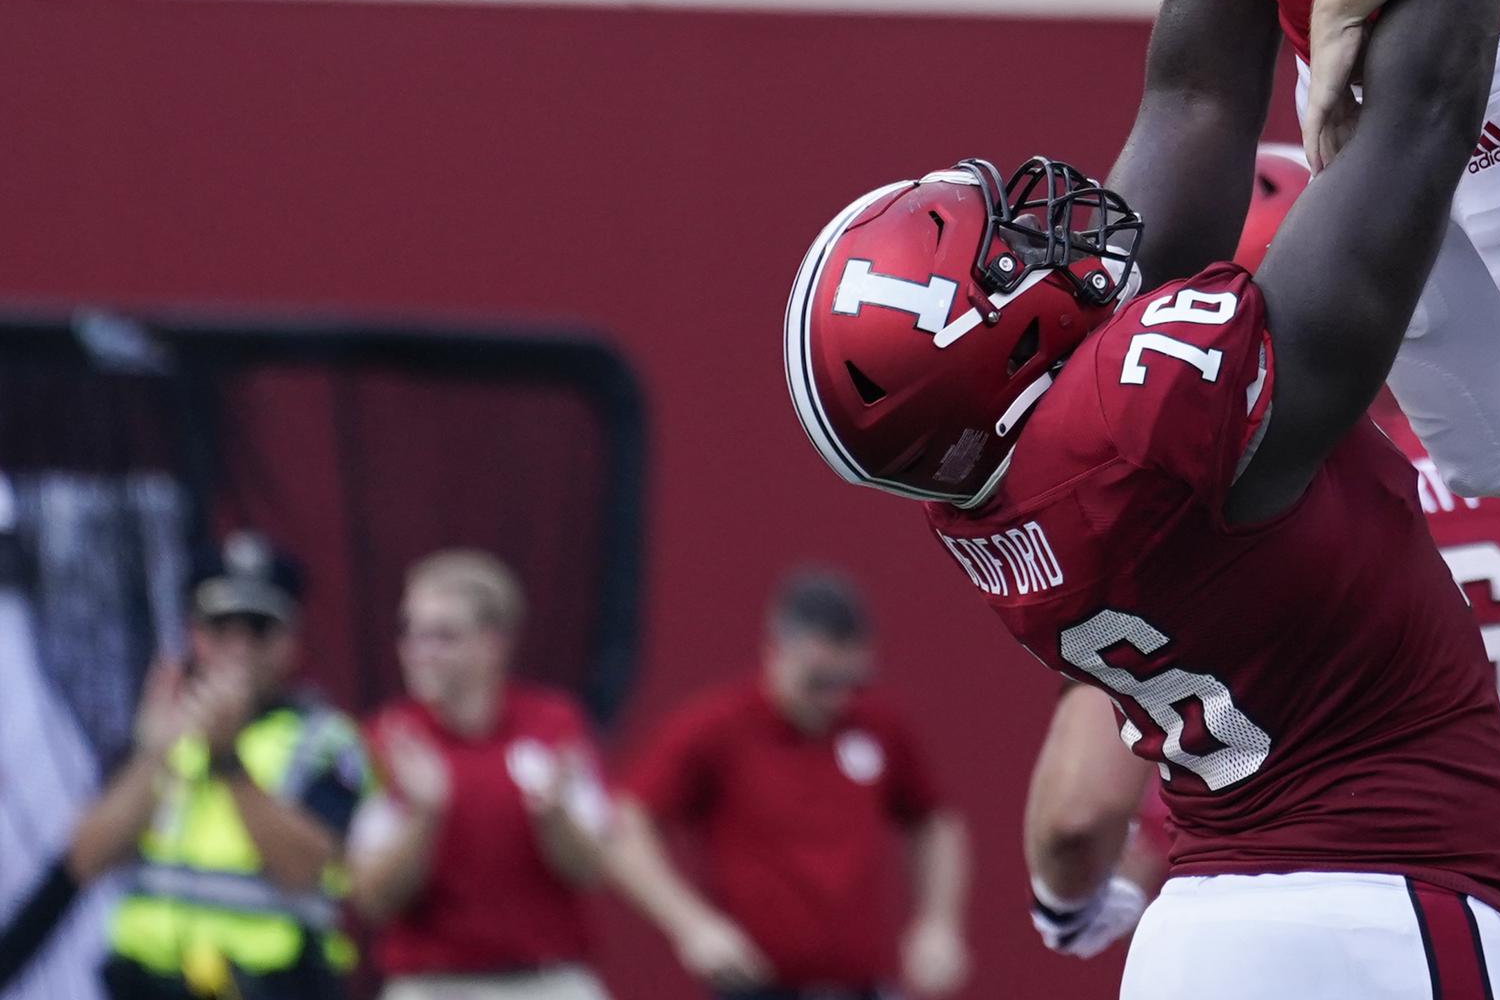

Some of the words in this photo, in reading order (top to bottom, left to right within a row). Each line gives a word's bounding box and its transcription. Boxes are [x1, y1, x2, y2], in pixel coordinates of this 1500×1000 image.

[1119, 288, 1239, 386] 76
[936, 520, 1064, 597] EDFORD
[1060, 608, 1272, 792] 6
